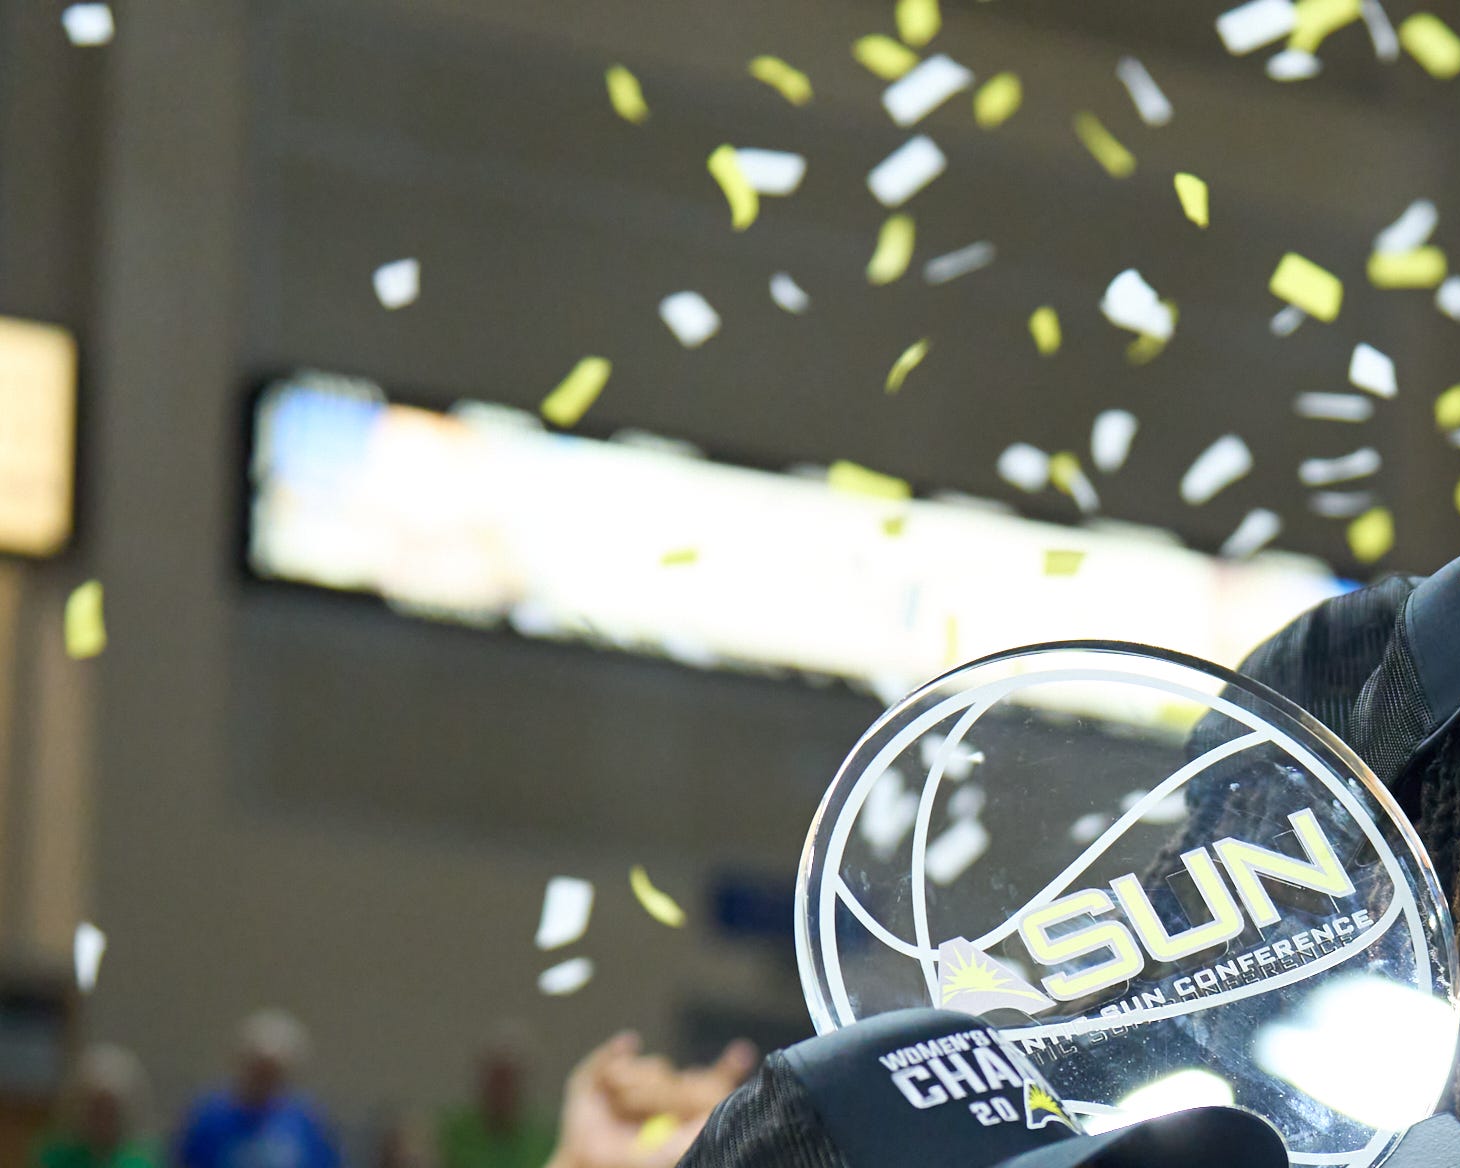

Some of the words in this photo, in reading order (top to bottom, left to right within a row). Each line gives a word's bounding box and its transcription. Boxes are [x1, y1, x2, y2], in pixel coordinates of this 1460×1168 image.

[1100, 986, 1166, 1025] SUN
[1173, 908, 1374, 997] CONFERENCE
[879, 1029, 991, 1072] WOMEN'S
[968, 1096, 1020, 1127] 20
